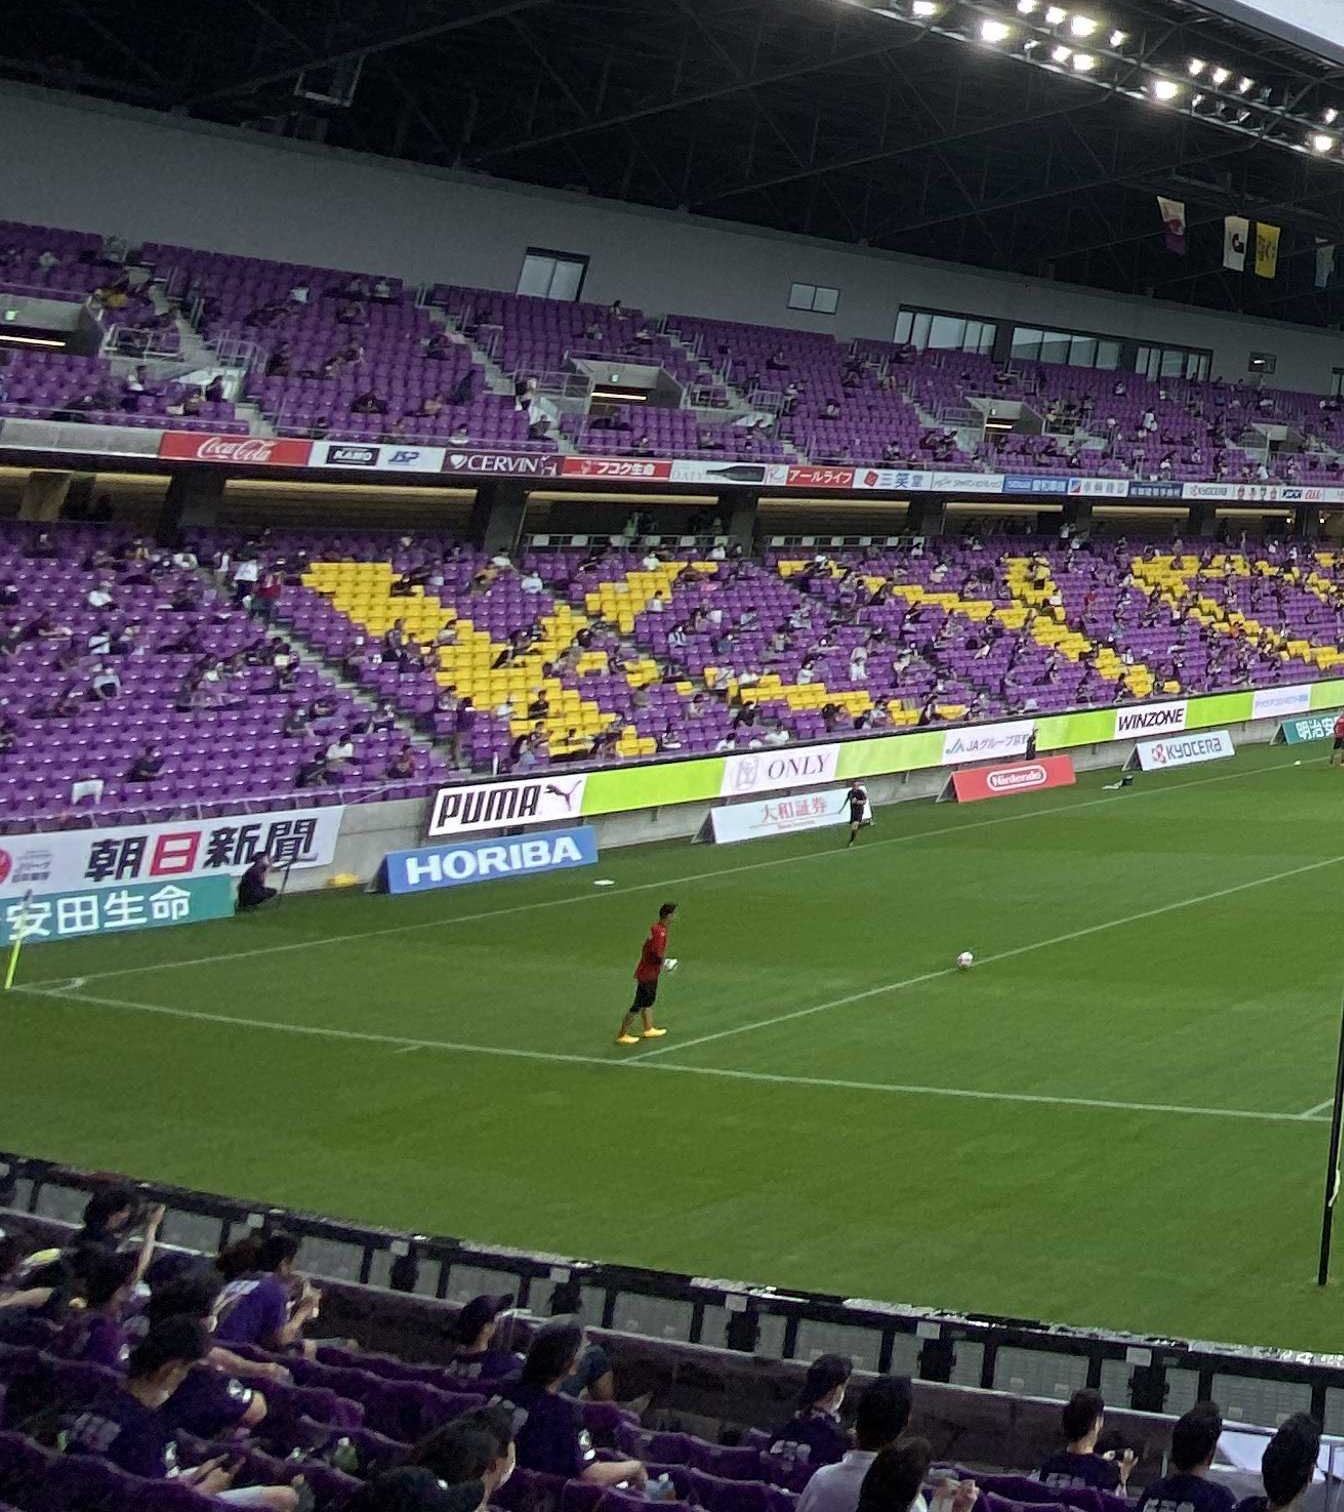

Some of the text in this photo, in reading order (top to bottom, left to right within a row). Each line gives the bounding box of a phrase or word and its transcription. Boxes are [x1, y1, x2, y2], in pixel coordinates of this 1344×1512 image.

[789, 468, 852, 485] アールライフ
[1118, 708, 1184, 731] WINZONE
[1165, 737, 1223, 759] KYOCERA
[766, 754, 827, 781] ONLY
[990, 769, 1042, 787] Nintendo
[436, 783, 541, 828] PUMA
[84, 817, 319, 883] 朝日新聞
[405, 835, 584, 886] HORIBA
